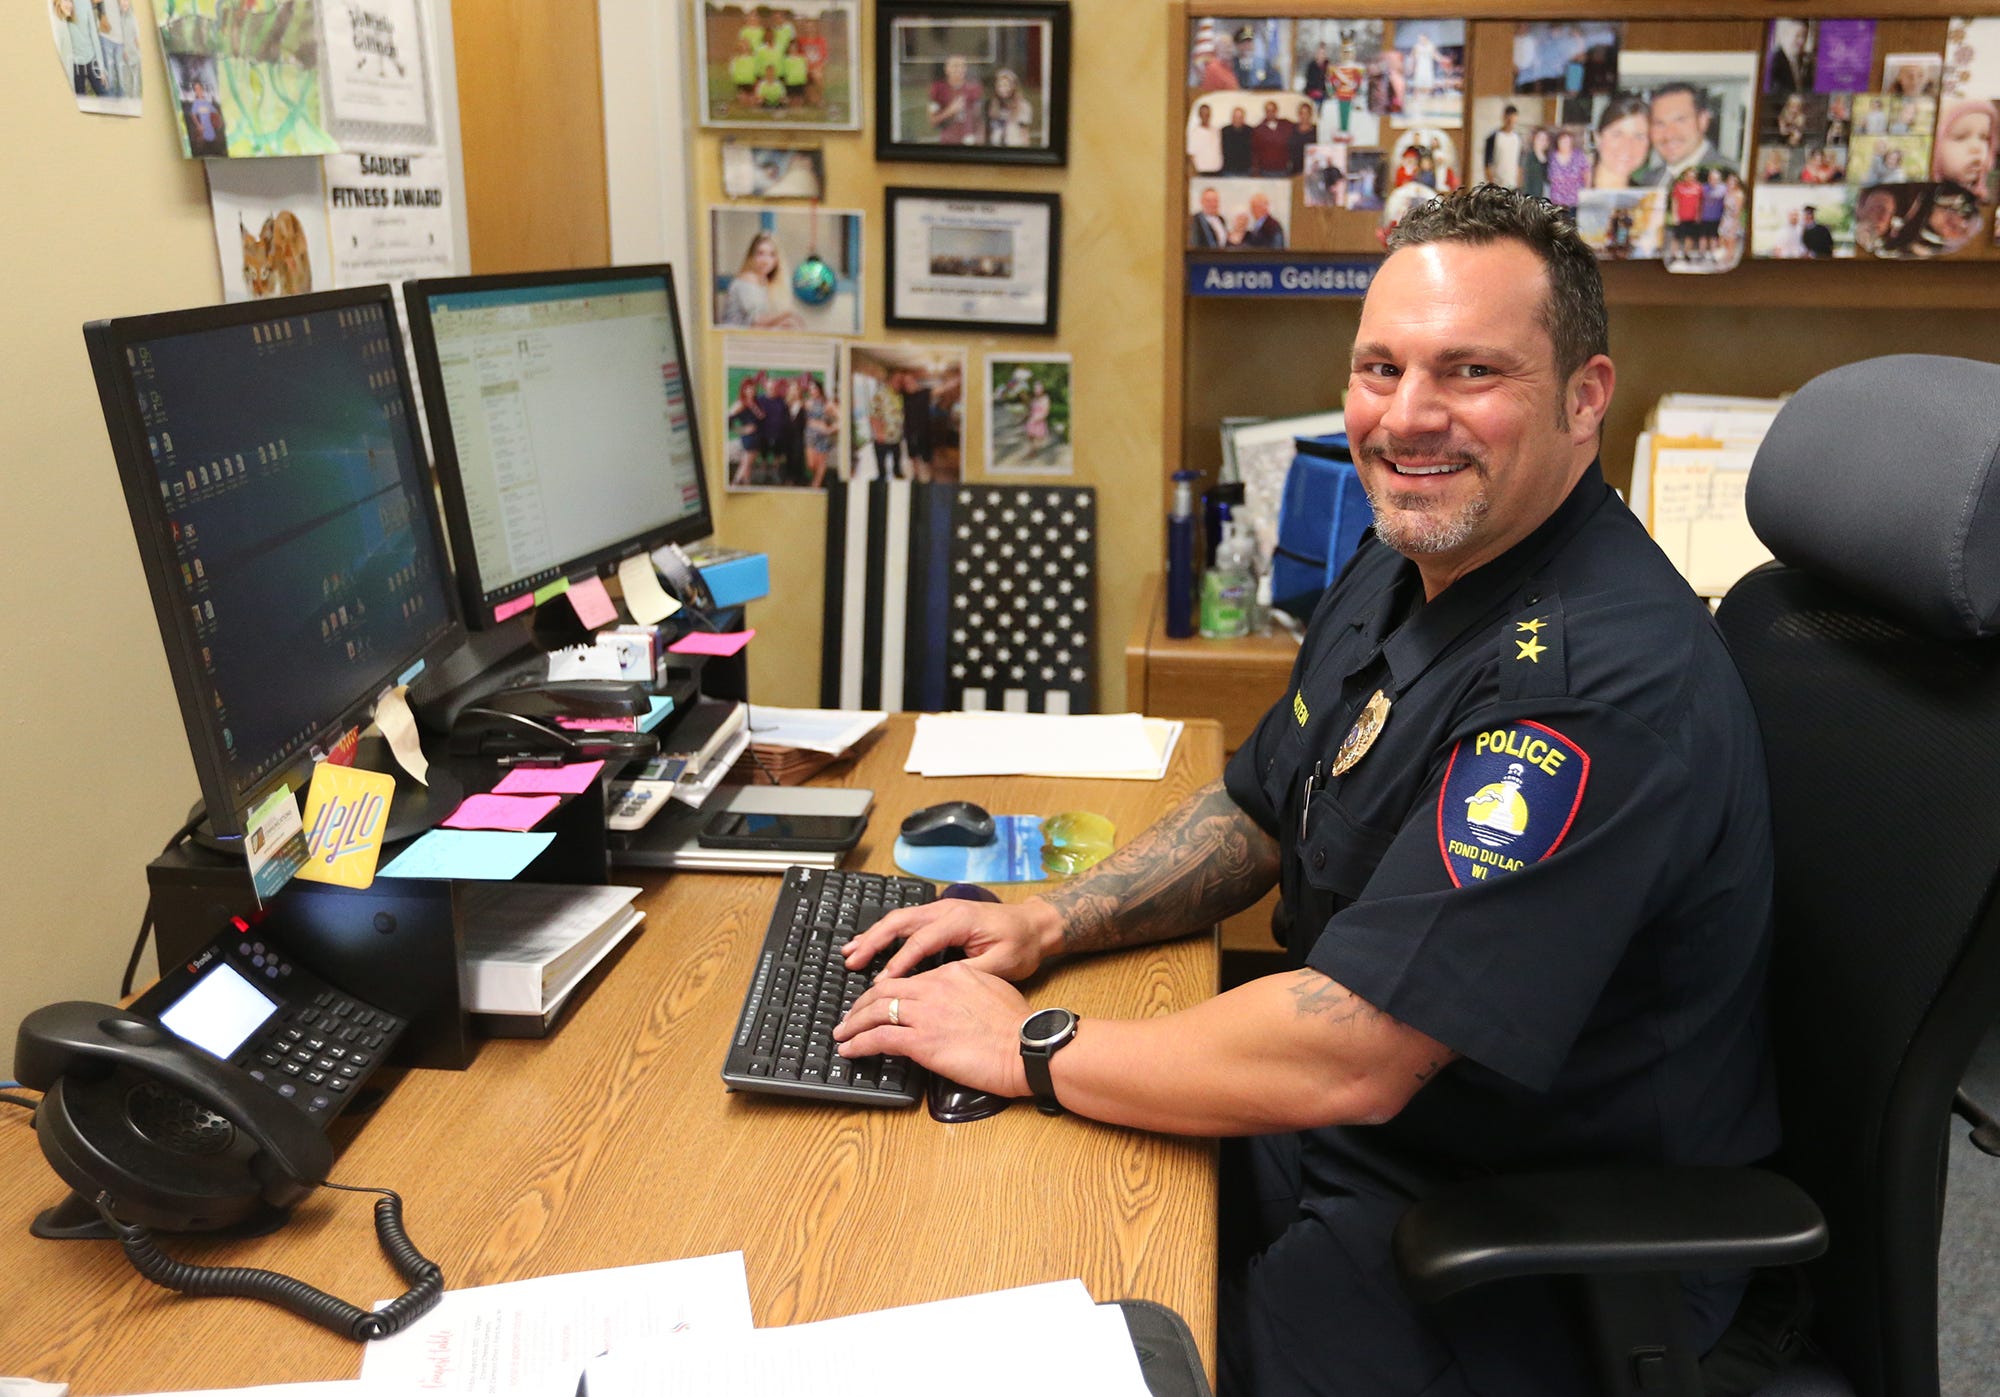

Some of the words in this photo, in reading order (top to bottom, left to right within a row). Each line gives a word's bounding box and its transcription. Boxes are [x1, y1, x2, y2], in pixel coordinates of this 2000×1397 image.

[360, 153, 411, 176] SABISK
[332, 187, 388, 208] FITNESS
[393, 187, 442, 208] AWARD
[1204, 266, 1273, 289] Aaron
[1475, 729, 1567, 776] POLICE
[1448, 839, 1479, 859] FOND
[1480, 848, 1499, 865] DU
[1498, 854, 1524, 872] LAC
[1471, 863, 1488, 881] WI
